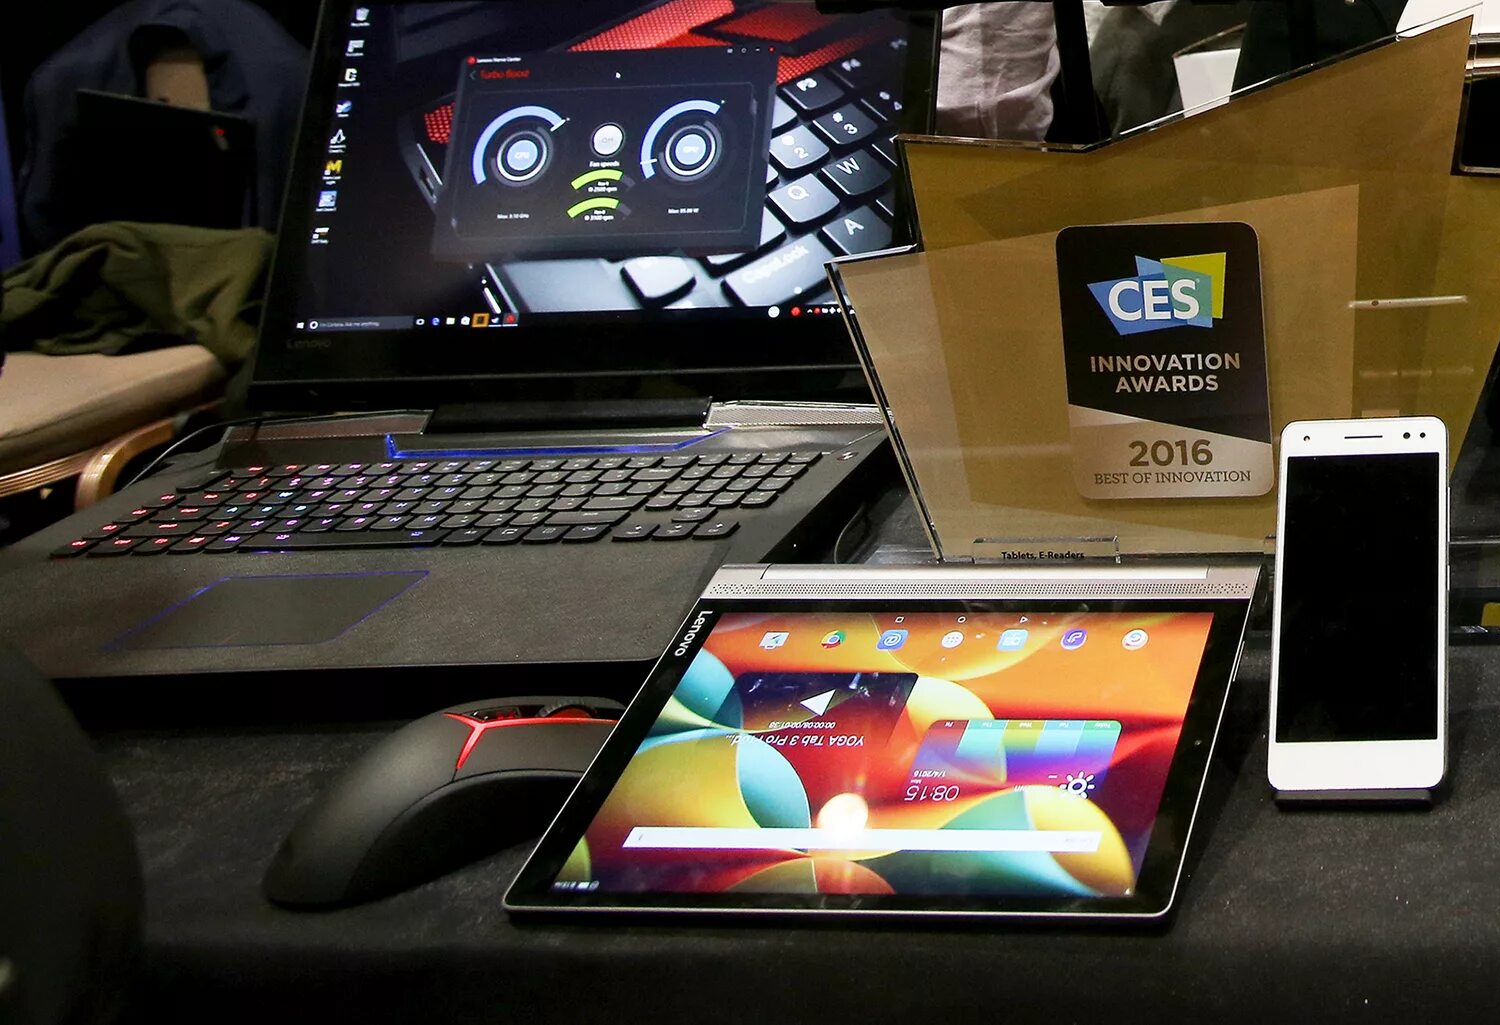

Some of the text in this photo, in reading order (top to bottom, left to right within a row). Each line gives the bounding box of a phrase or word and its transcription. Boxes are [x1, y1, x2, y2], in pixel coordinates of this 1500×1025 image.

[837, 158, 860, 175] W
[788, 185, 809, 200] Q
[845, 218, 864, 236] A
[1108, 279, 1200, 321] CES
[1090, 352, 1241, 374] INNOVATION
[1115, 375, 1219, 393] AWARDS
[1129, 439, 1213, 467] 2016
[1094, 470, 1251, 485] BEST OF INNOVATION
[1001, 551, 1085, 560] Tablets, E-Readers
[674, 611, 713, 656] Lenovo
[766, 734, 788, 746] Pro
[790, 735, 800, 747] 3
[802, 735, 825, 747] Tab
[829, 735, 864, 747] YOGA
[904, 784, 960, 801] 08:15
